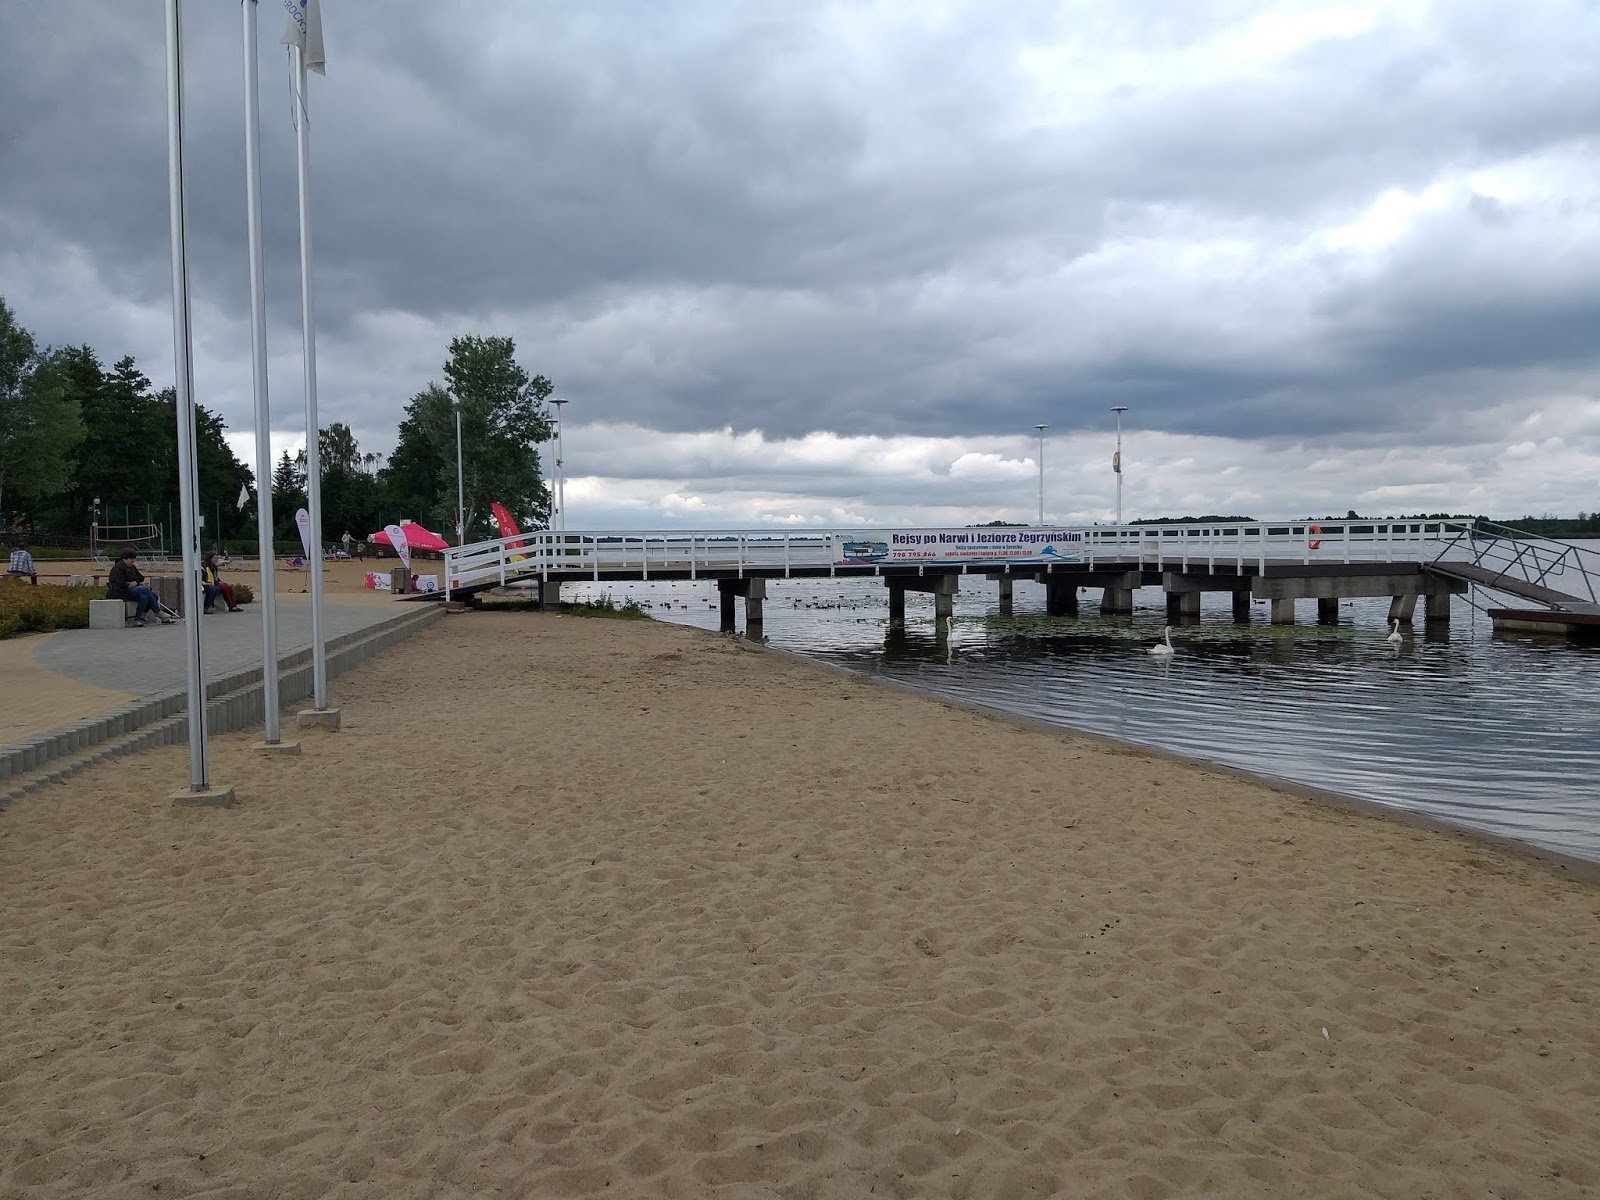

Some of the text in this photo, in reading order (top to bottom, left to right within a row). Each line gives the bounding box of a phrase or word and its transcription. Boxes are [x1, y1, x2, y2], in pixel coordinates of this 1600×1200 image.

[892, 532, 1081, 544] Rejsy po Narwi i Jeziorze Zegrzyńskim
